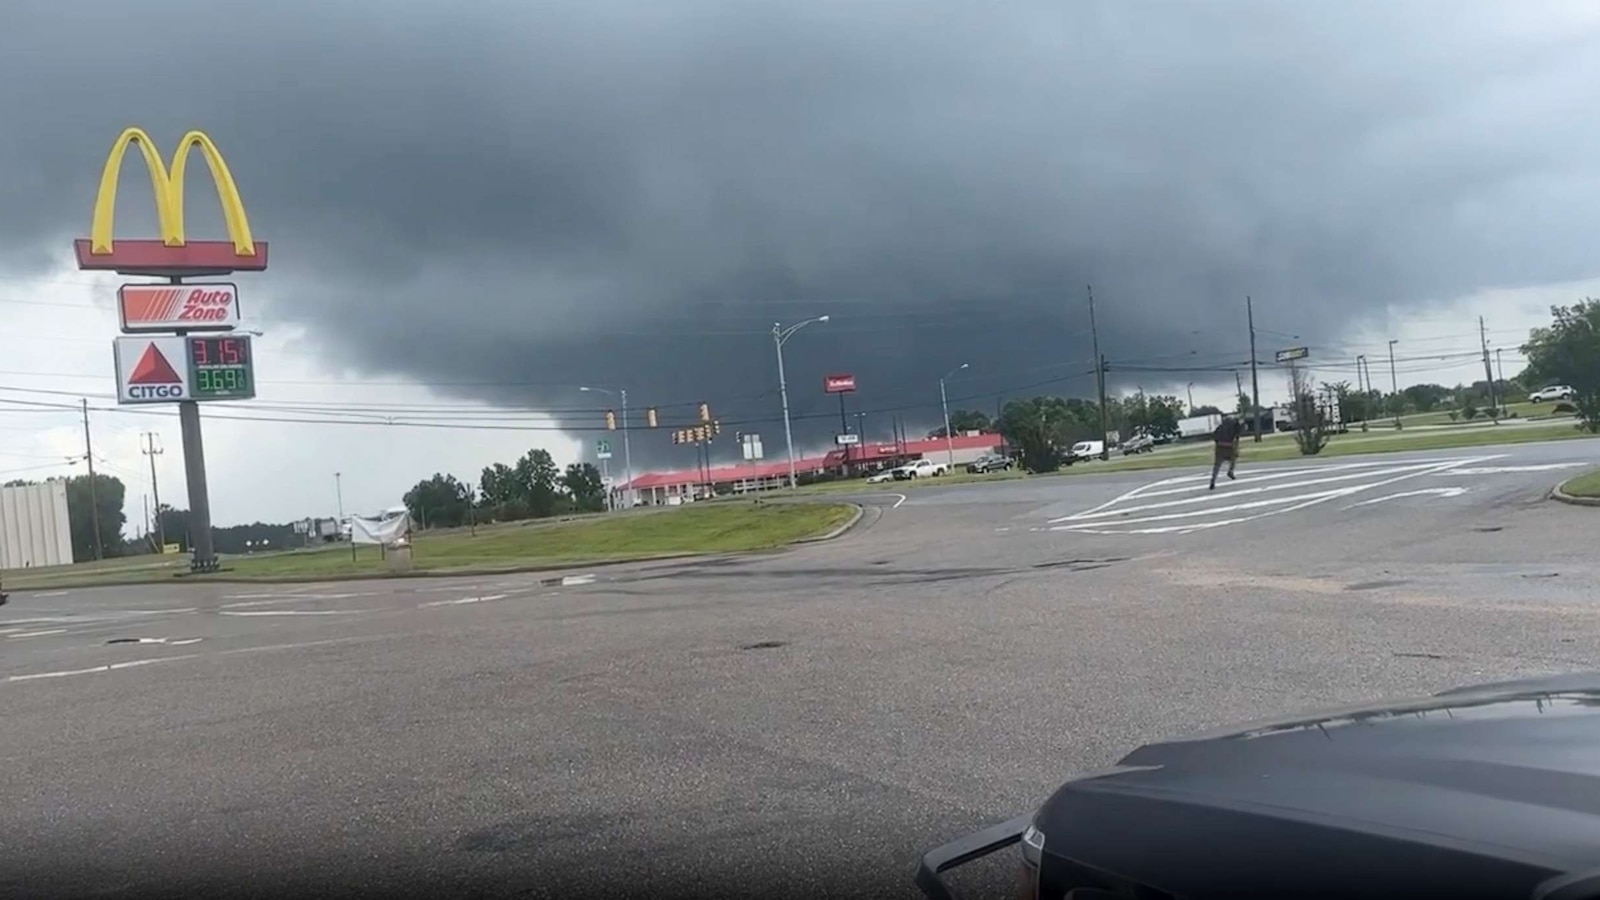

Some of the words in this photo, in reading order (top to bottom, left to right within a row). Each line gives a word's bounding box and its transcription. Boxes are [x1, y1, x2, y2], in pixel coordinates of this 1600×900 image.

[186, 289, 232, 305] Auto
[178, 305, 227, 321] Zone
[129, 385, 182, 398] CITGO
